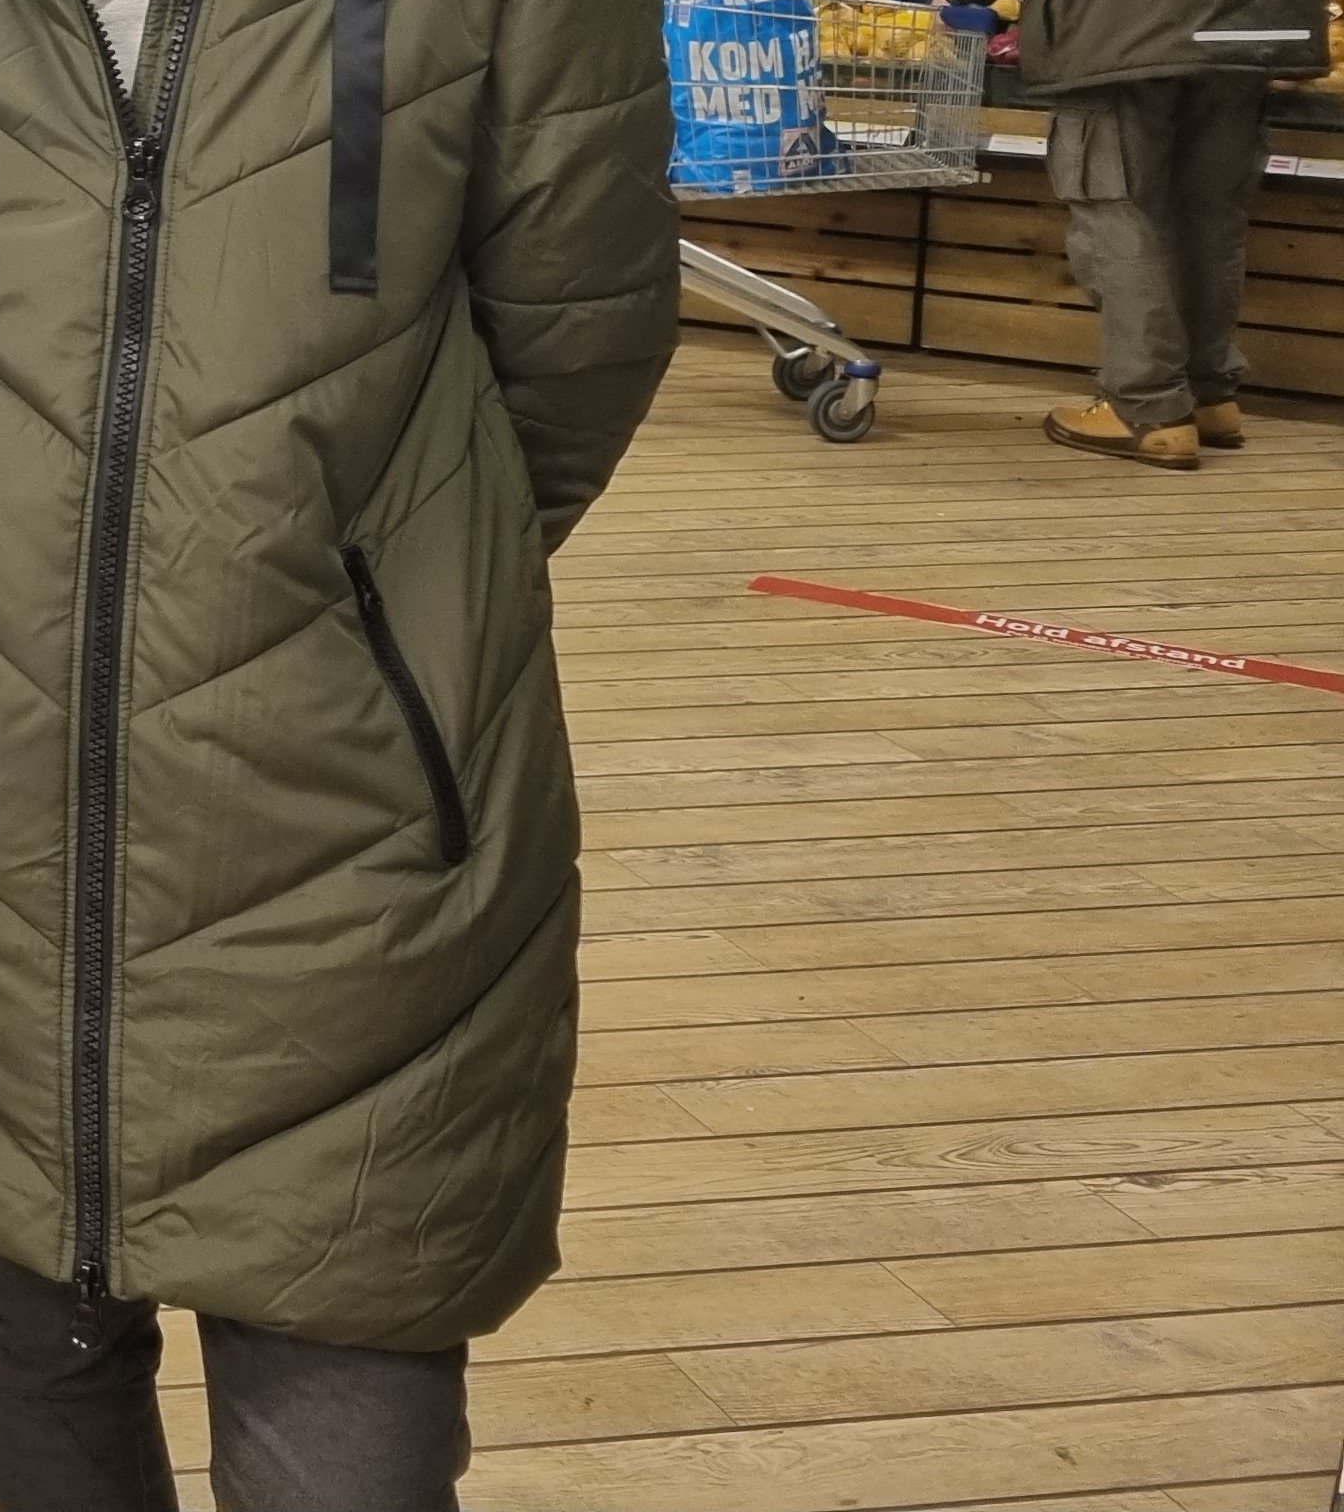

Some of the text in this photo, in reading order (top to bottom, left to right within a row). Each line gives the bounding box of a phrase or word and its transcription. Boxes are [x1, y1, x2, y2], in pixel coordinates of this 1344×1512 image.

[689, 37, 784, 82] KOM
[691, 85, 783, 125] MED
[975, 614, 1069, 639] Hold
[1083, 632, 1248, 670] afstand
